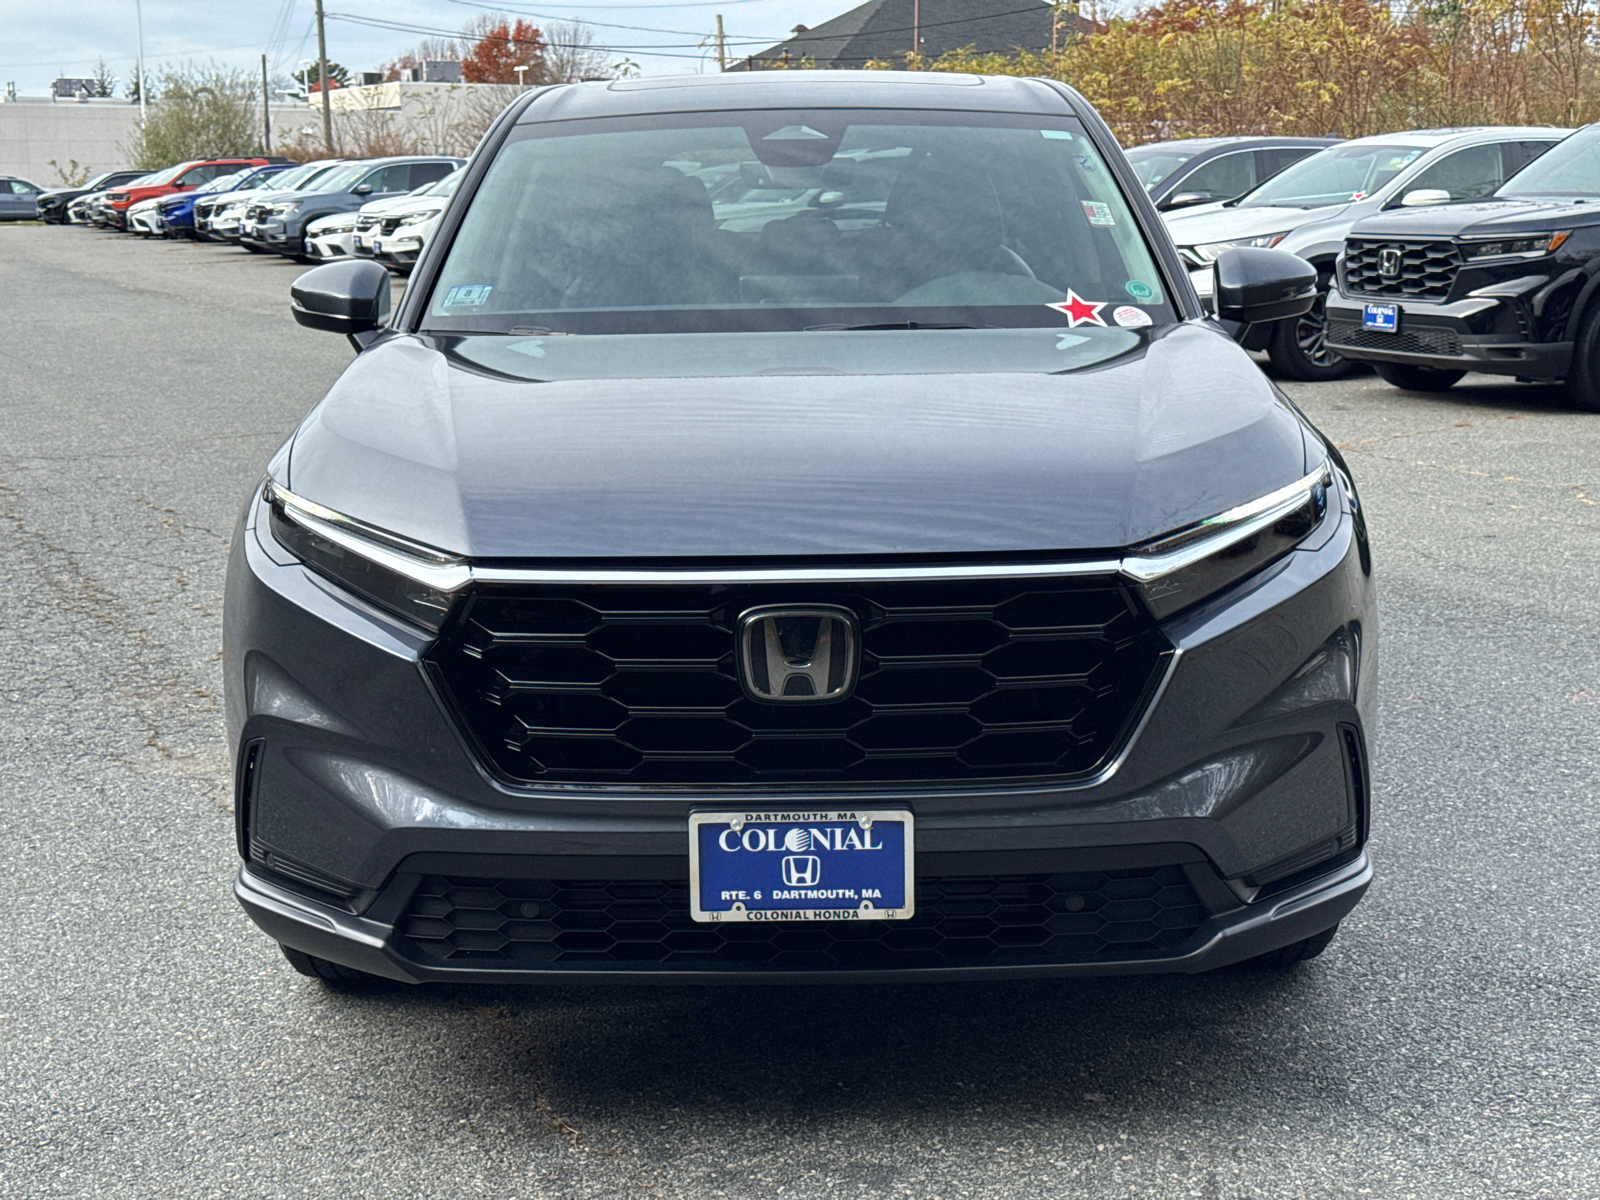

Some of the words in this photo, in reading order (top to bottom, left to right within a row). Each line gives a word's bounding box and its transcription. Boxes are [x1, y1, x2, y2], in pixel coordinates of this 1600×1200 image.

[745, 813, 832, 821] DARTMOUTH,
[837, 812, 857, 820] MA
[718, 827, 883, 852] COLONIAL
[721, 890, 750, 900] RTE.
[753, 890, 762, 900] 6
[772, 889, 859, 900] DARTMOUTH,
[861, 888, 882, 898] MA
[746, 911, 810, 921] COLONIAL
[813, 910, 860, 920] HONDA
